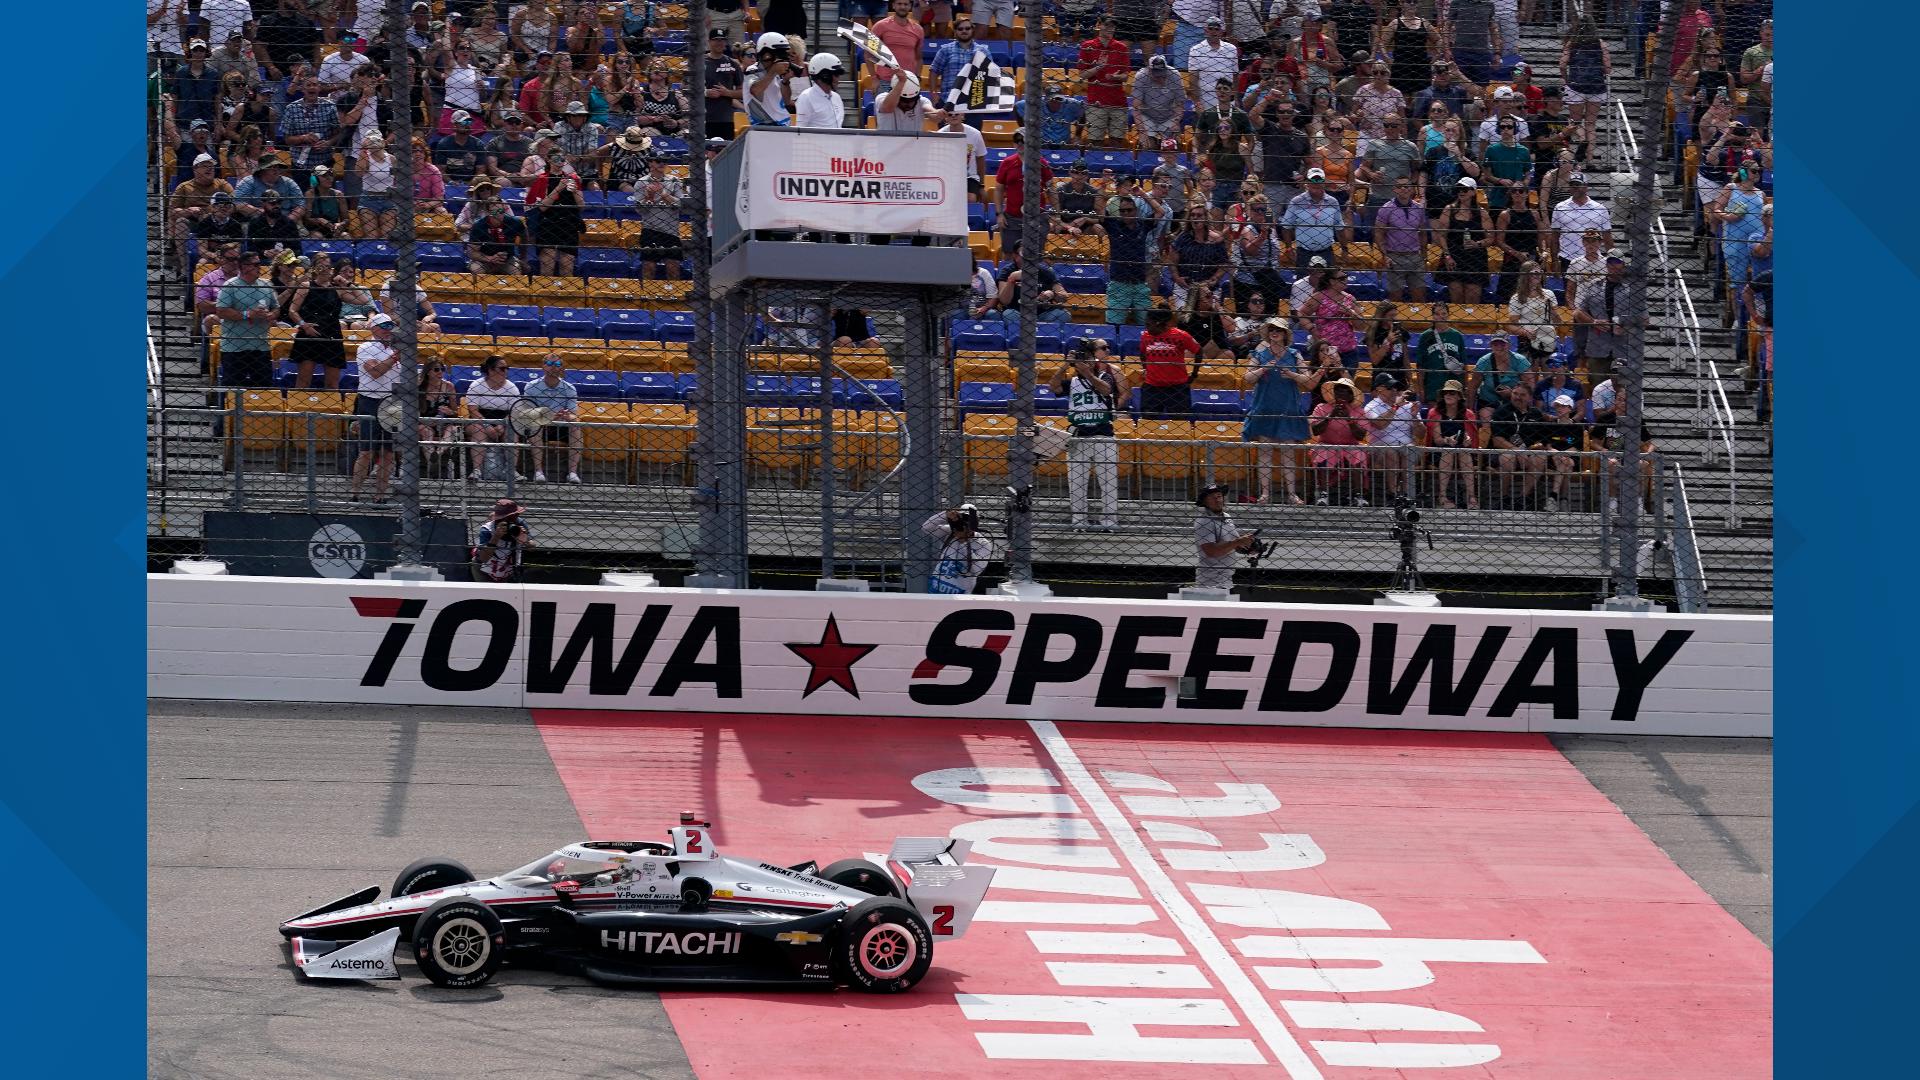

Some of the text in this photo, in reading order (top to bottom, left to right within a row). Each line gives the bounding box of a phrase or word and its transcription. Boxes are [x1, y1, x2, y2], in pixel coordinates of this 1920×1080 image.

[831, 157, 885, 177] HyVee
[780, 177, 882, 200] INDYCAR
[883, 181, 912, 191] RACE
[884, 191, 939, 200] WEEKEND
[312, 543, 362, 561] csm
[349, 596, 1695, 722] IOWA SPEEDWAY
[686, 829, 703, 854] 2
[760, 862, 839, 891] PENSKE Truck Rental
[932, 905, 954, 935] 2
[600, 929, 742, 955] HITACHI
[331, 959, 385, 970] Astemo
